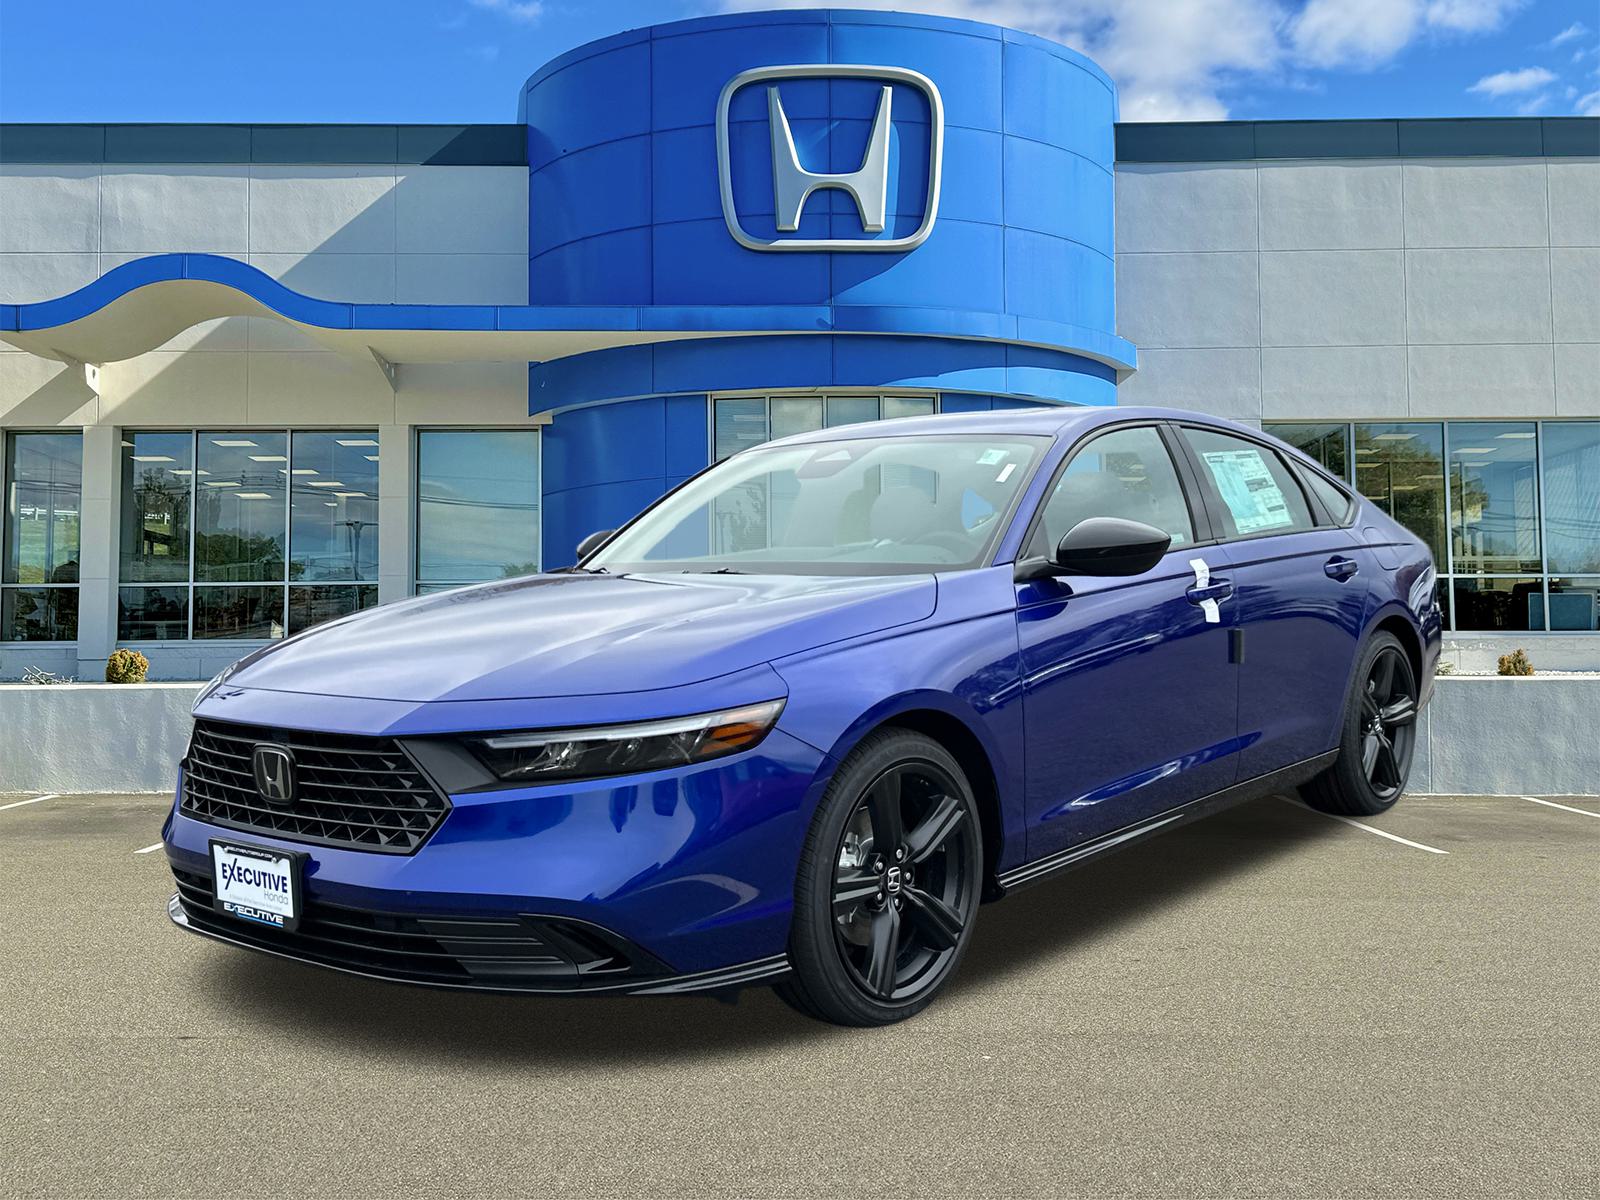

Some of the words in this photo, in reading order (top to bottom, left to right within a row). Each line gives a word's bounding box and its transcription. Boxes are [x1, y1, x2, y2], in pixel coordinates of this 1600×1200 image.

[222, 858, 287, 893] EXECUTIVE
[264, 889, 289, 905] Honda
[223, 902, 284, 924] EXECUTIVE
